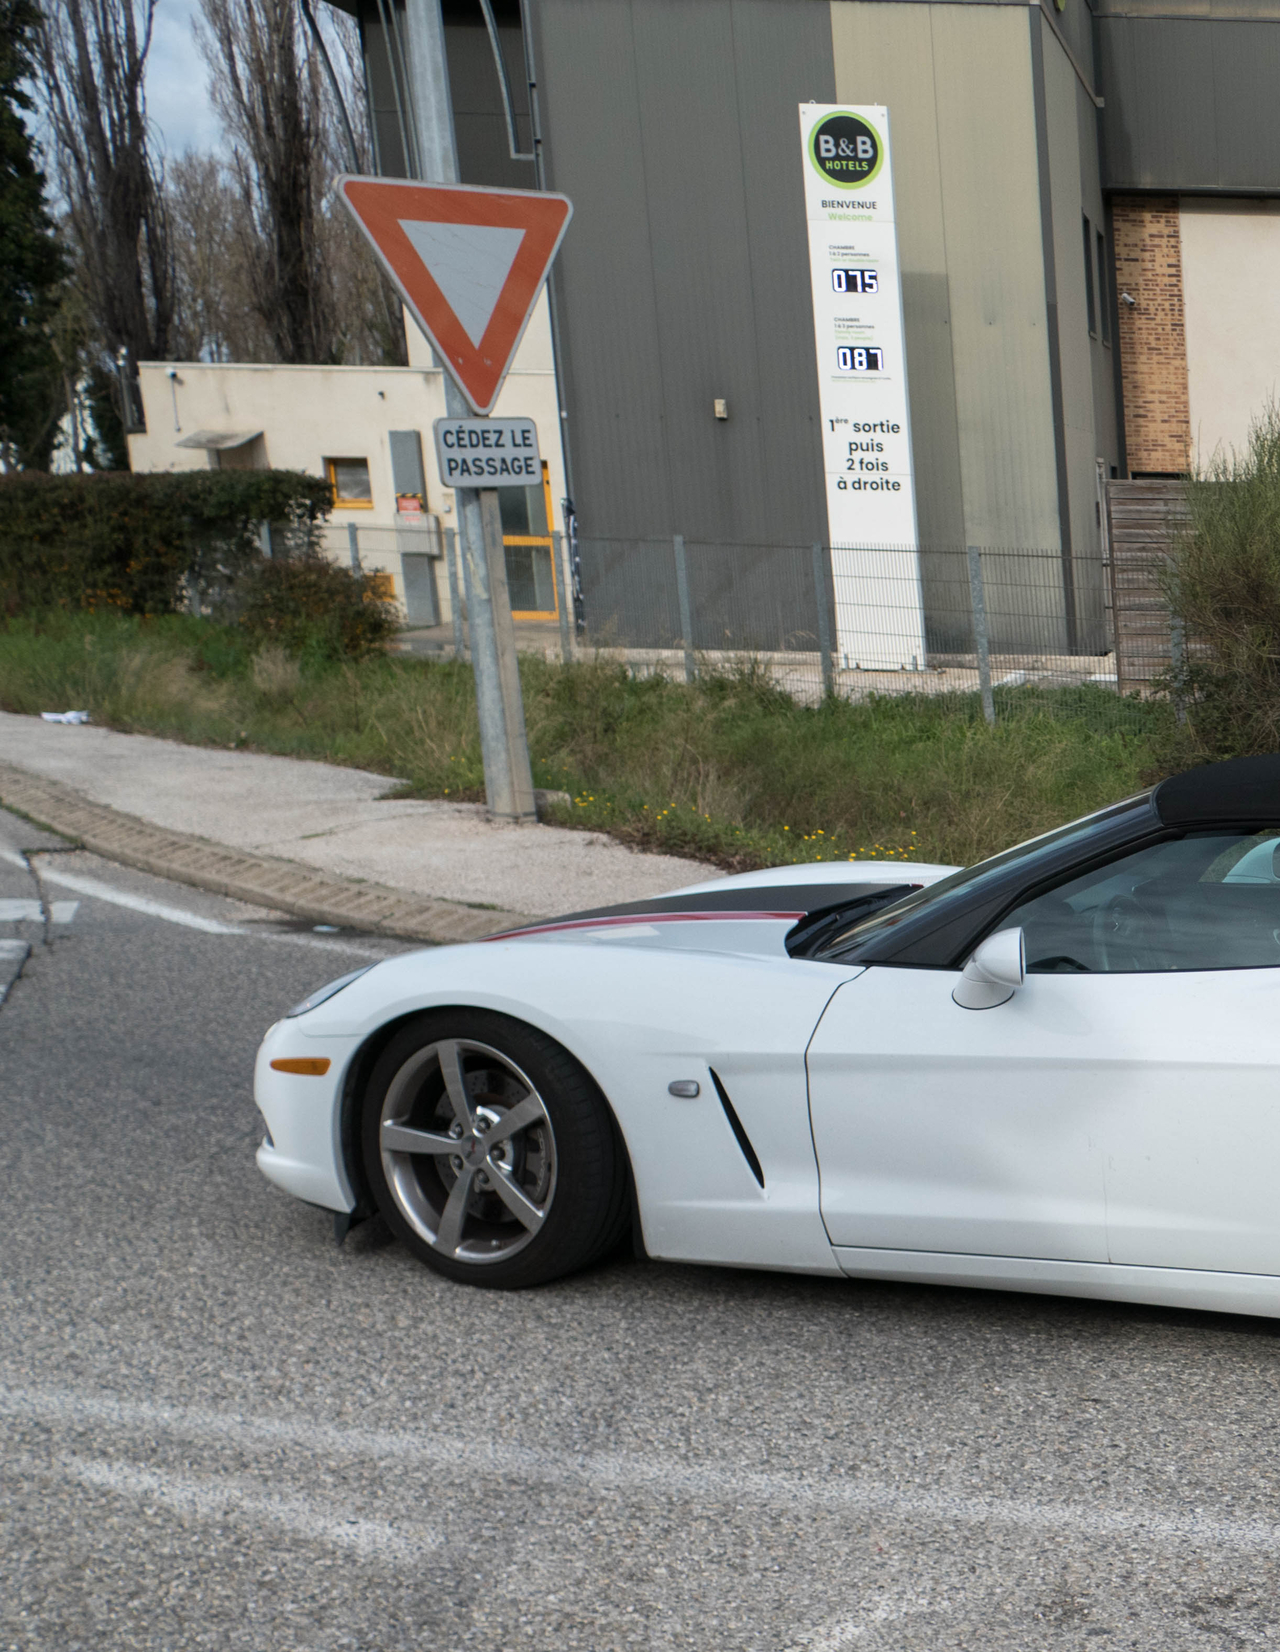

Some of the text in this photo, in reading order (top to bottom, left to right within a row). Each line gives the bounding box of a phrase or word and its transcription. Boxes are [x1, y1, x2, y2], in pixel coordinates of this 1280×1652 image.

[819, 134, 874, 158] B&B
[825, 160, 869, 171] HOTELS
[821, 199, 878, 210] BIENVENUE
[828, 212, 874, 221] Welcome
[832, 270, 878, 293] 075
[838, 348, 883, 371] 087
[829, 416, 901, 434] 1ère sortie
[443, 425, 533, 448] CÉDEZ LE
[848, 438, 884, 455] puis
[446, 456, 536, 476] PASSAGE
[846, 458, 889, 471] 2 fois
[837, 476, 901, 491] à droite
